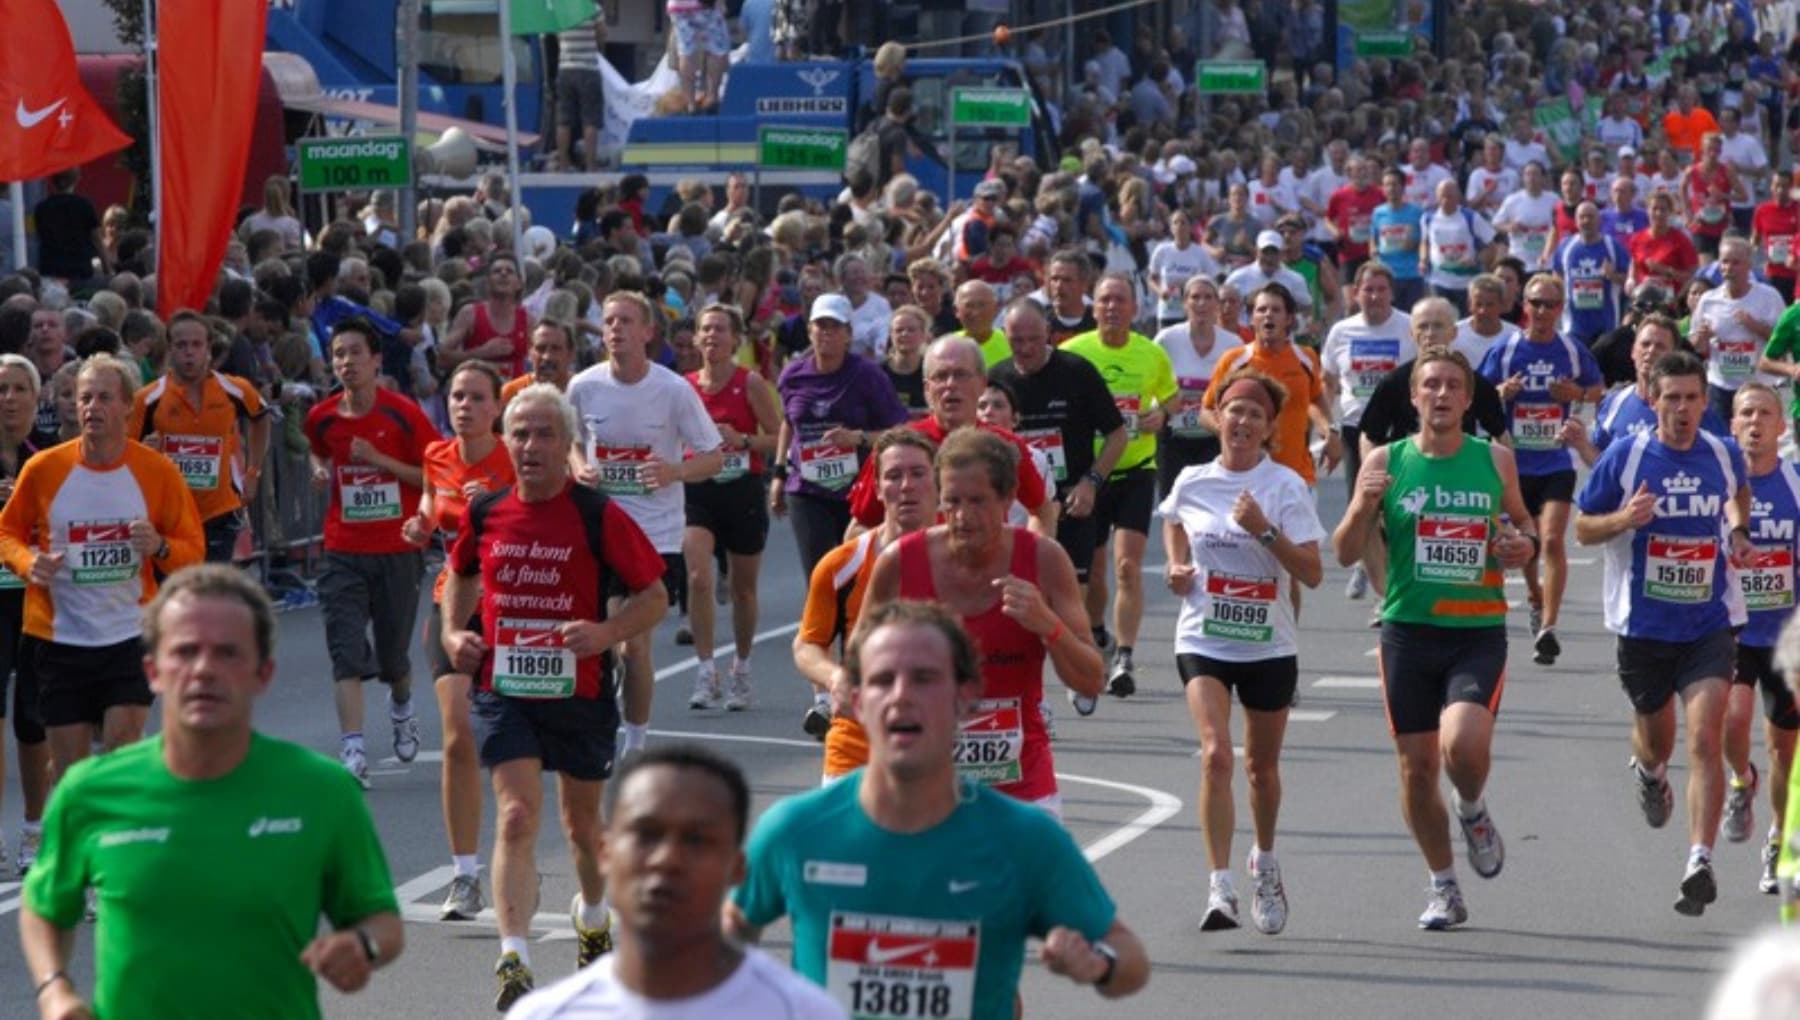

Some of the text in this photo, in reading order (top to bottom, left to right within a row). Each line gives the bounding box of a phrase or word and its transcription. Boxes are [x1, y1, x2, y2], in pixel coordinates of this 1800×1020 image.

[766, 132, 843, 149] maandag
[307, 142, 402, 160] maandag
[322, 165, 391, 185] 100 m
[353, 490, 386, 506] 8071
[1435, 485, 1491, 509] bam
[1653, 495, 1720, 517] KLM
[82, 547, 131, 567] 11238
[528, 540, 573, 561] komt
[1424, 544, 1480, 564] 14659
[496, 563, 561, 587] de finish
[1656, 565, 1706, 584] 15160
[1741, 573, 1785, 593] 5823
[1211, 601, 1268, 625] 10699
[506, 654, 563, 676] 11890
[500, 677, 564, 693] maandag
[953, 740, 1011, 764] 2362
[848, 979, 951, 1018] 13818
